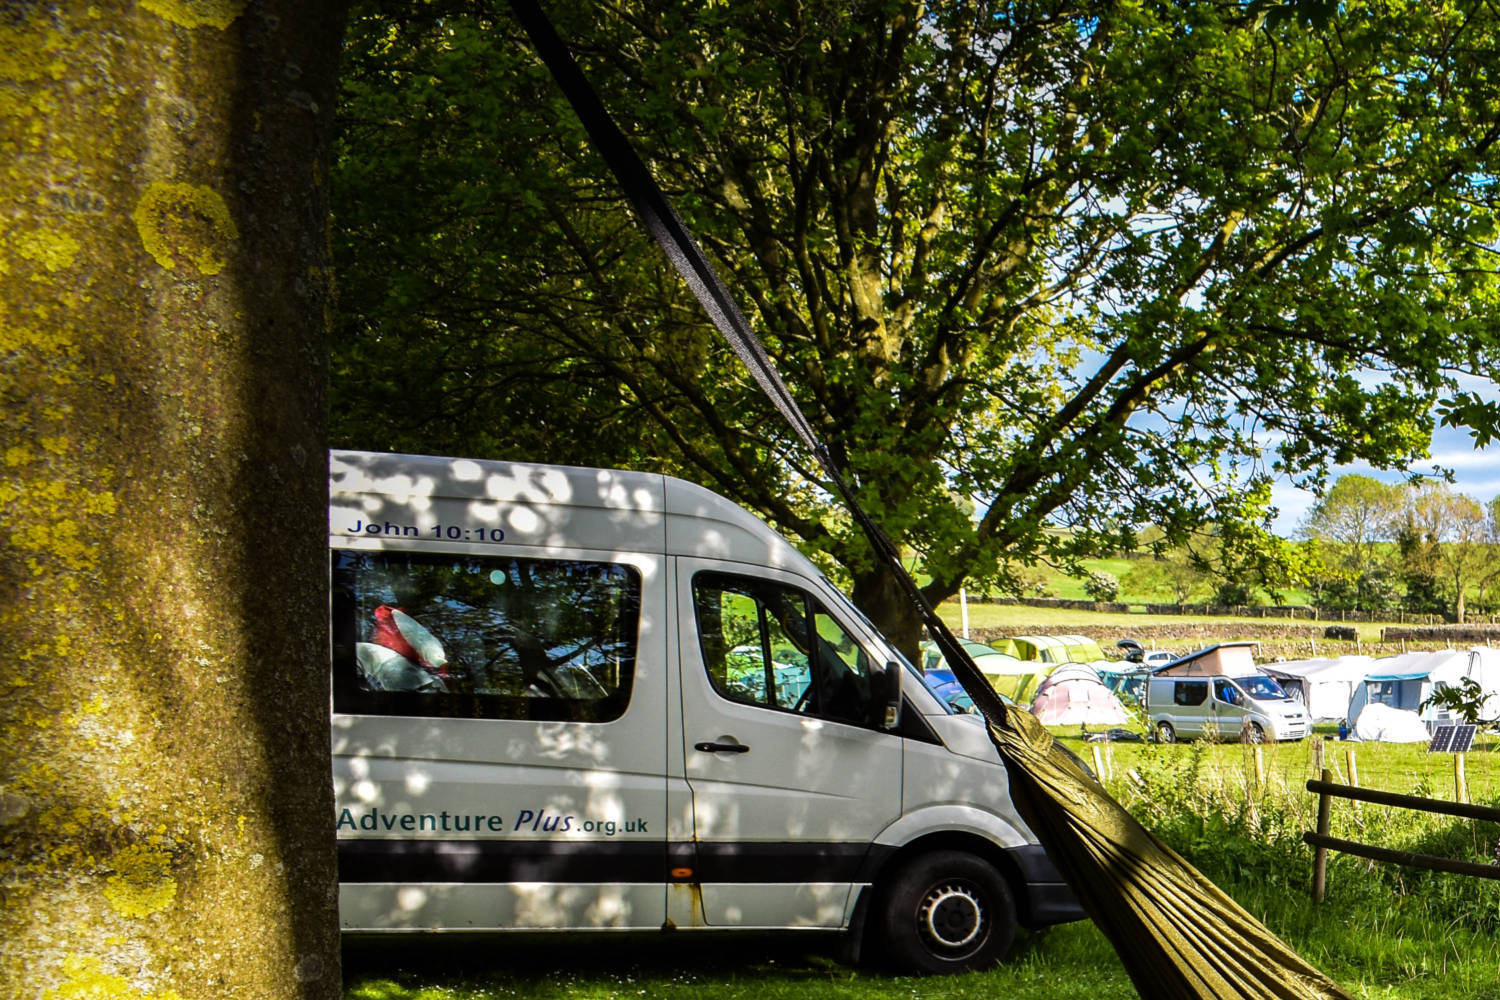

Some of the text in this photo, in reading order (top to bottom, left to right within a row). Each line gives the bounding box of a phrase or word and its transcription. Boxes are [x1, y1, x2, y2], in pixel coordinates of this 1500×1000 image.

[347, 520, 505, 542] John 10:10
[336, 807, 503, 831] Adventure
